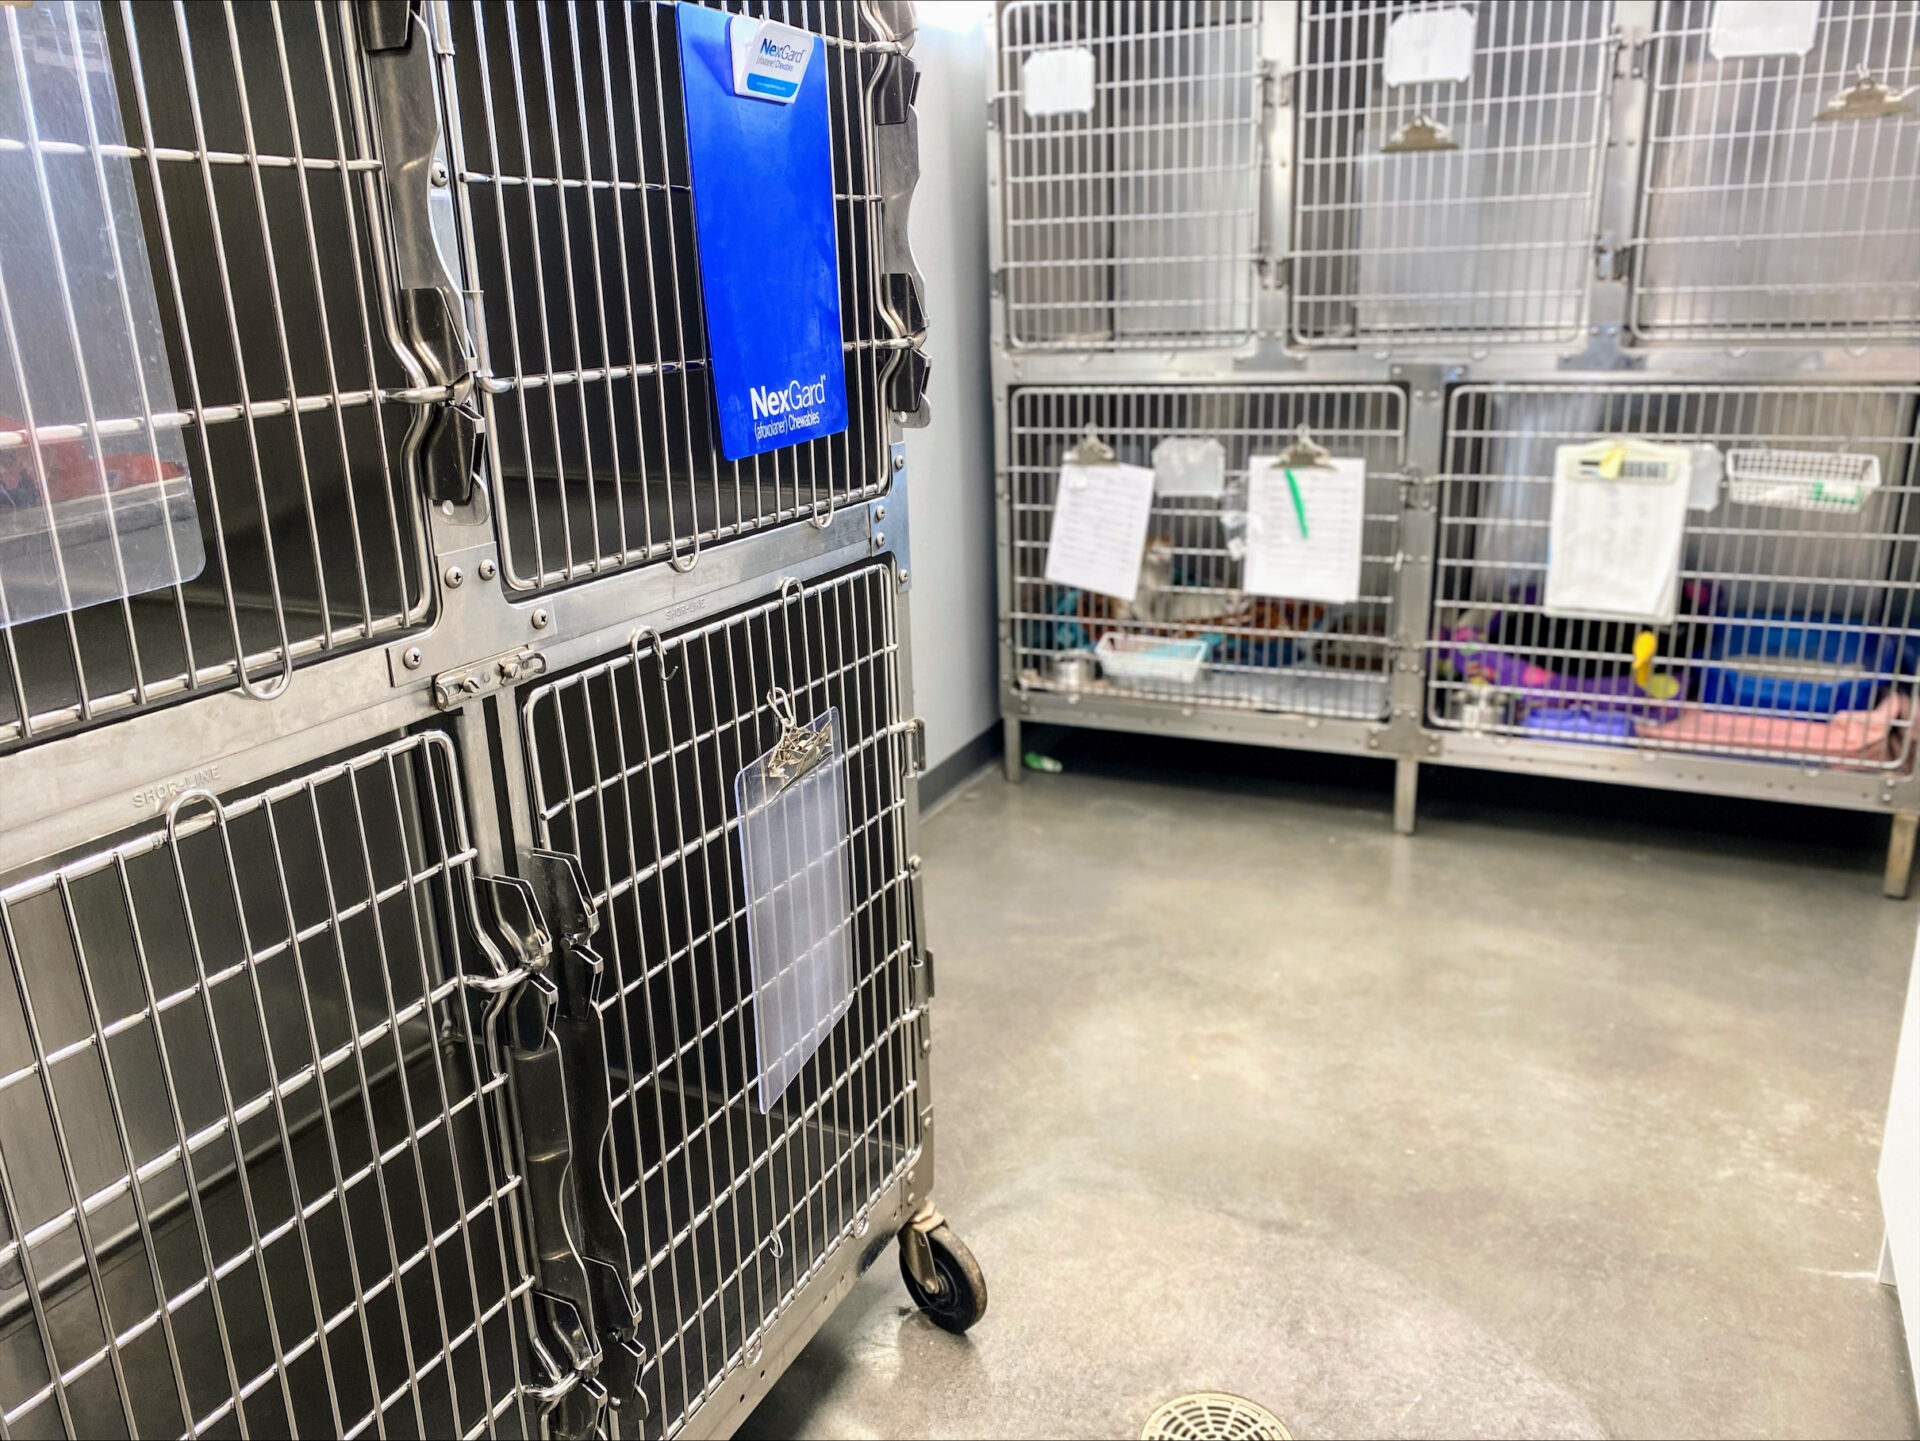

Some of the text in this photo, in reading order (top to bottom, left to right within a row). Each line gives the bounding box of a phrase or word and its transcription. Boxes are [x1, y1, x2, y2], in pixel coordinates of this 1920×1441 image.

[760, 38, 804, 63] NexGard
[750, 374, 826, 420] NexGard
[788, 409, 820, 431] Chewables
[665, 598, 706, 621] SHOR-LNE
[132, 765, 222, 808] SHOR-LINE
